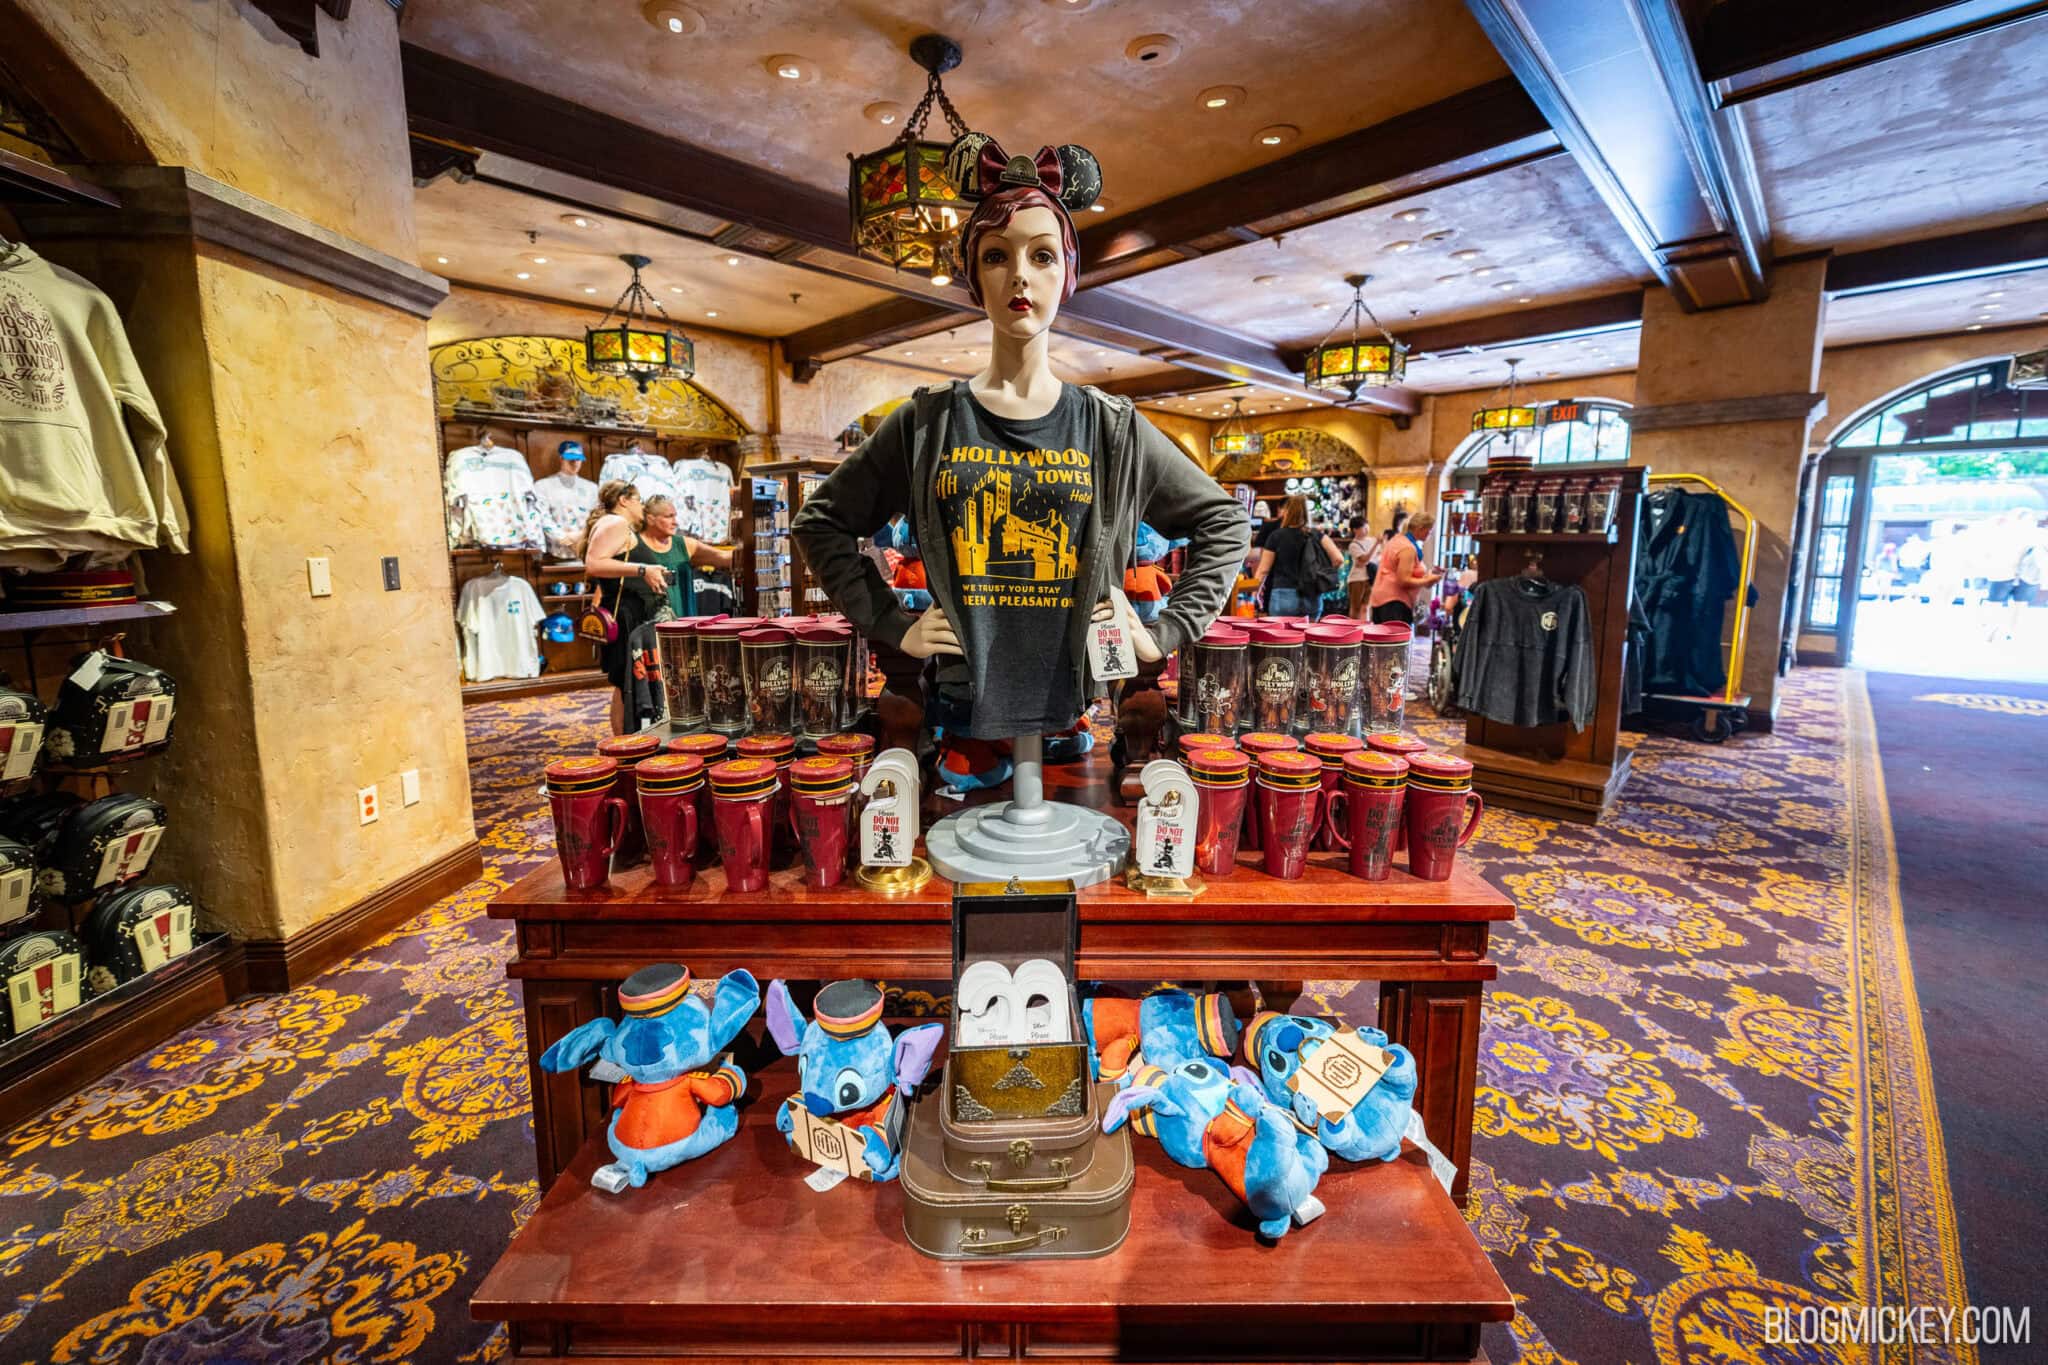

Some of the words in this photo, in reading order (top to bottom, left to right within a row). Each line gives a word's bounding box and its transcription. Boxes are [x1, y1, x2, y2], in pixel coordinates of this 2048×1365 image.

[1552, 404, 1578, 421] EXIT
[951, 446, 1090, 468] HOLLYWOOD
[1035, 469, 1093, 487] TOWER
[1070, 488, 1093, 505] Hotel
[962, 584, 977, 593] WE
[979, 584, 1005, 593] TRUST
[1008, 585, 1035, 594] YOUR
[1037, 586, 1061, 594] STAY
[989, 596, 996, 606] A
[999, 595, 1058, 608] PLEASANT
[1097, 629, 1108, 638] DO
[1108, 628, 1121, 637] NOT
[873, 816, 885, 825] DO
[886, 817, 900, 825] NOT
[1157, 825, 1168, 834] DO
[1169, 828, 1184, 837] NOT
